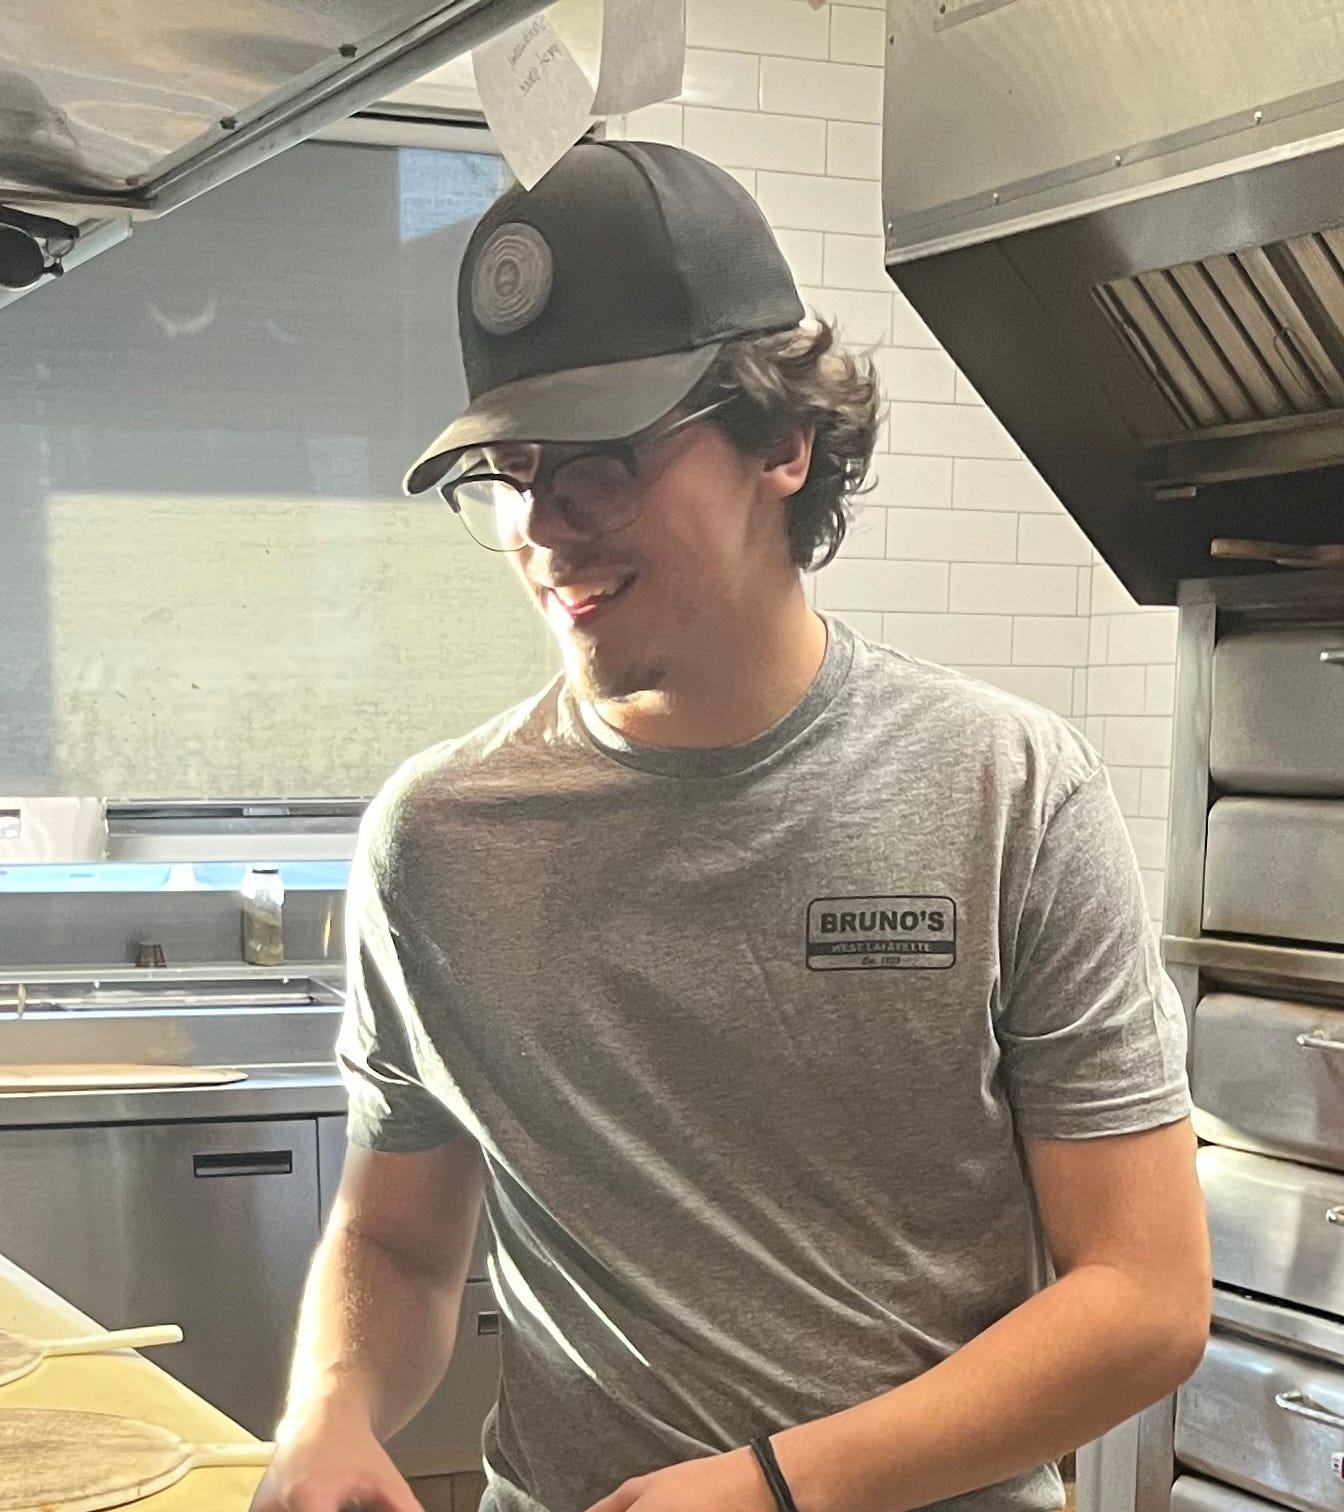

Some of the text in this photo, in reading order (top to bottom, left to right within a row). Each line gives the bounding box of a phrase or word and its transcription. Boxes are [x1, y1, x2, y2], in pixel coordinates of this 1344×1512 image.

[820, 911, 945, 933] BRUNO'S
[831, 942, 930, 952] WEST LAFAYETTE
